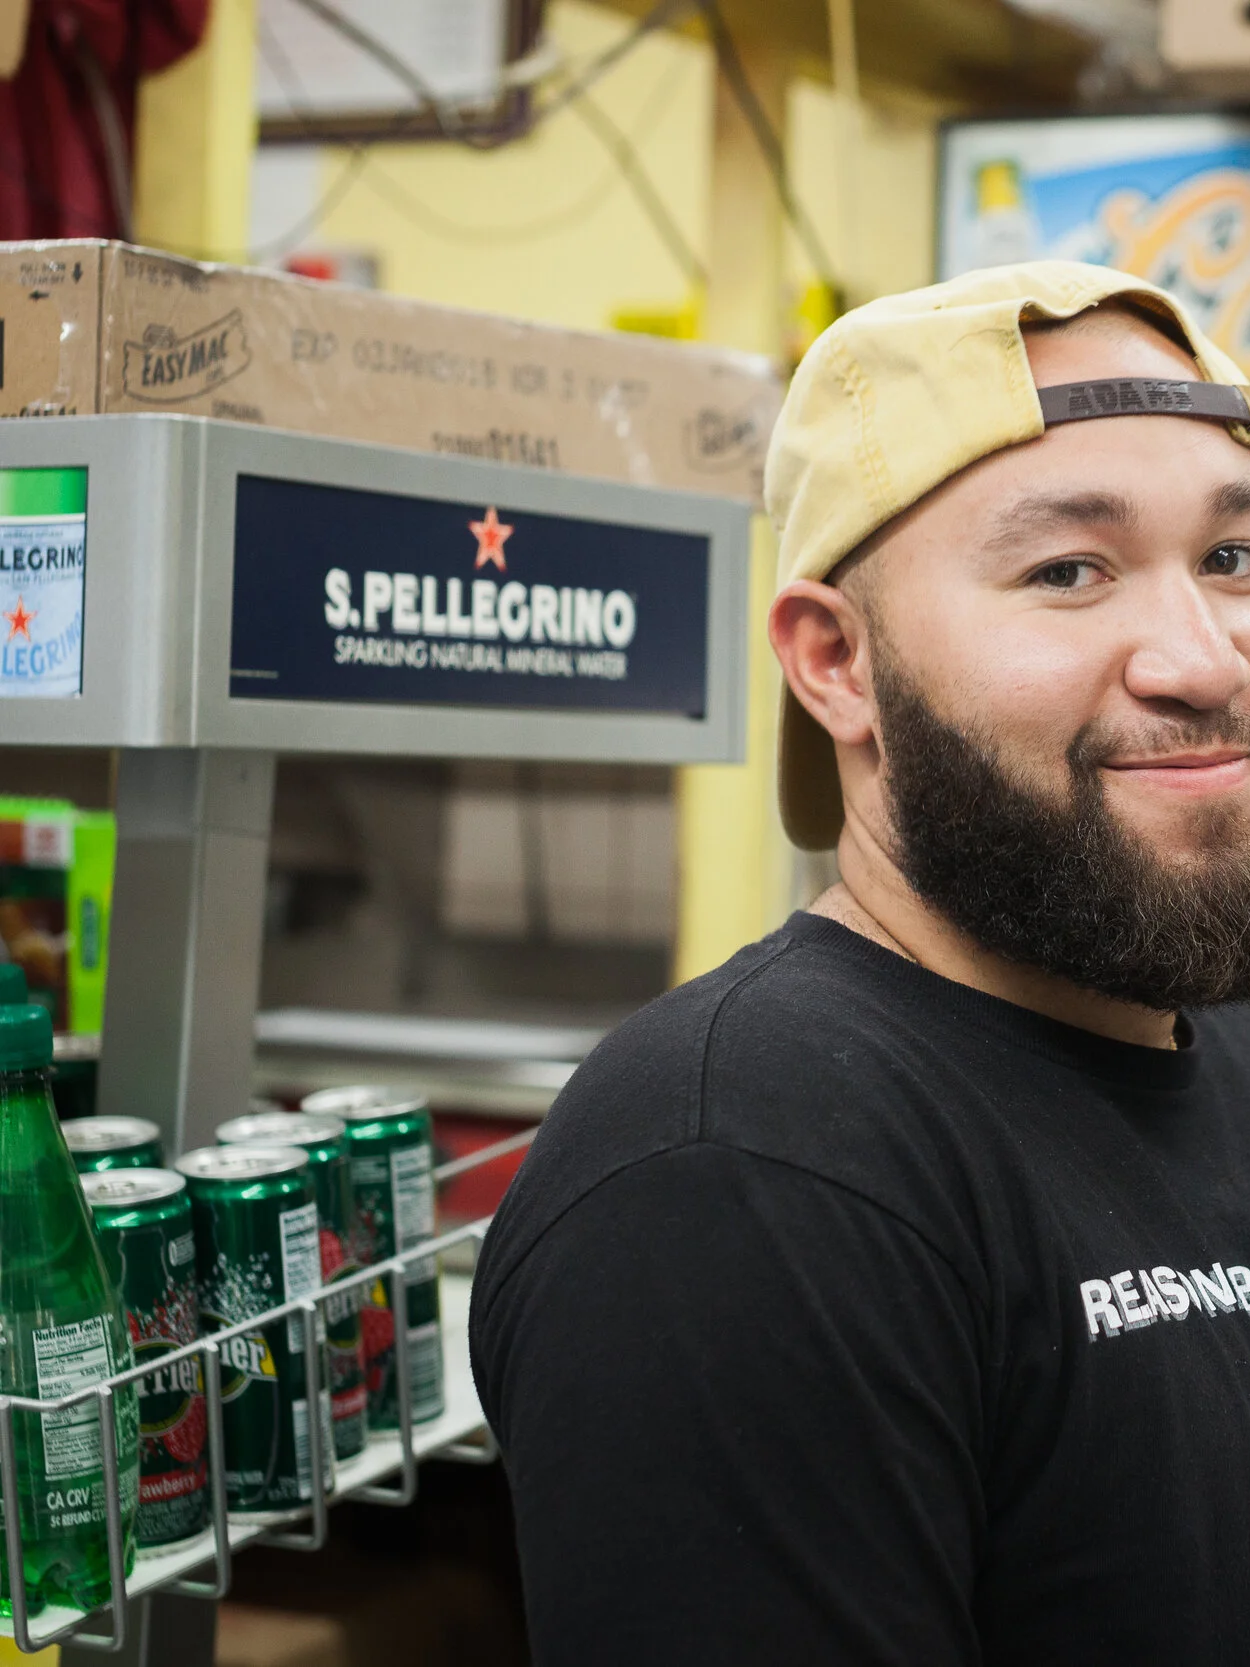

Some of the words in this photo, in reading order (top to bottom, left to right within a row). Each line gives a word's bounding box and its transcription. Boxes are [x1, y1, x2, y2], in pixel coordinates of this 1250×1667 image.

[142, 351, 187, 387] EASY
[188, 330, 229, 377] MAC
[324, 566, 636, 649] S.PELLEGRINO
[334, 635, 428, 669] SPARKLING
[430, 643, 503, 673] NATURAL
[504, 650, 574, 678] MINERAL
[575, 651, 627, 680] WATER
[35, 1325, 78, 1341] Nutrition
[80, 1318, 102, 1333] Facts
[46, 1490, 65, 1510] CA
[66, 1486, 91, 1507] CRV
[141, 1471, 197, 1499] awberry
[61, 1509, 92, 1527] REFUND
